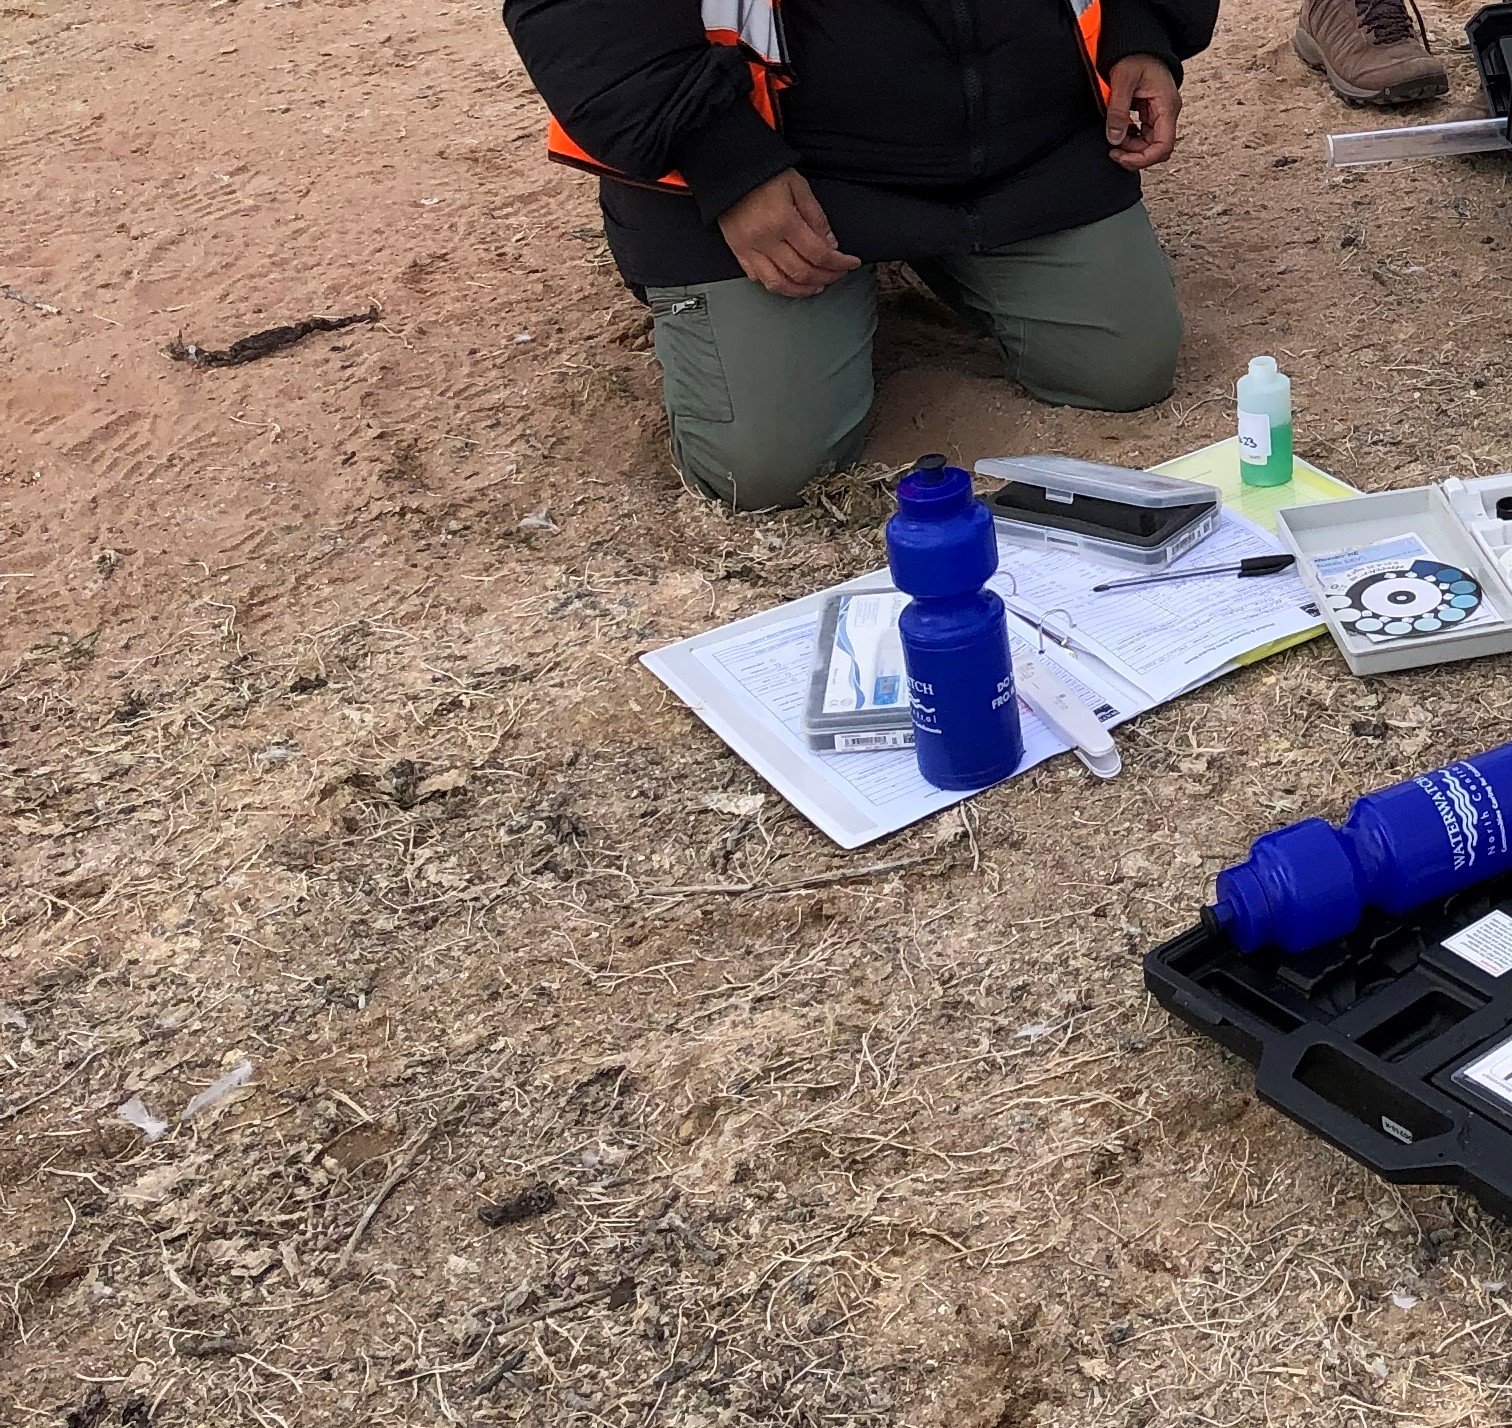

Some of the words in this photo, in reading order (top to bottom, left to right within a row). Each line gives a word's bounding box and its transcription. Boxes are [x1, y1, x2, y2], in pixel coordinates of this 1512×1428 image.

[997, 676, 1009, 692] DO
[1413, 775, 1466, 872] WATERWATCH
[1480, 810, 1497, 856] North
